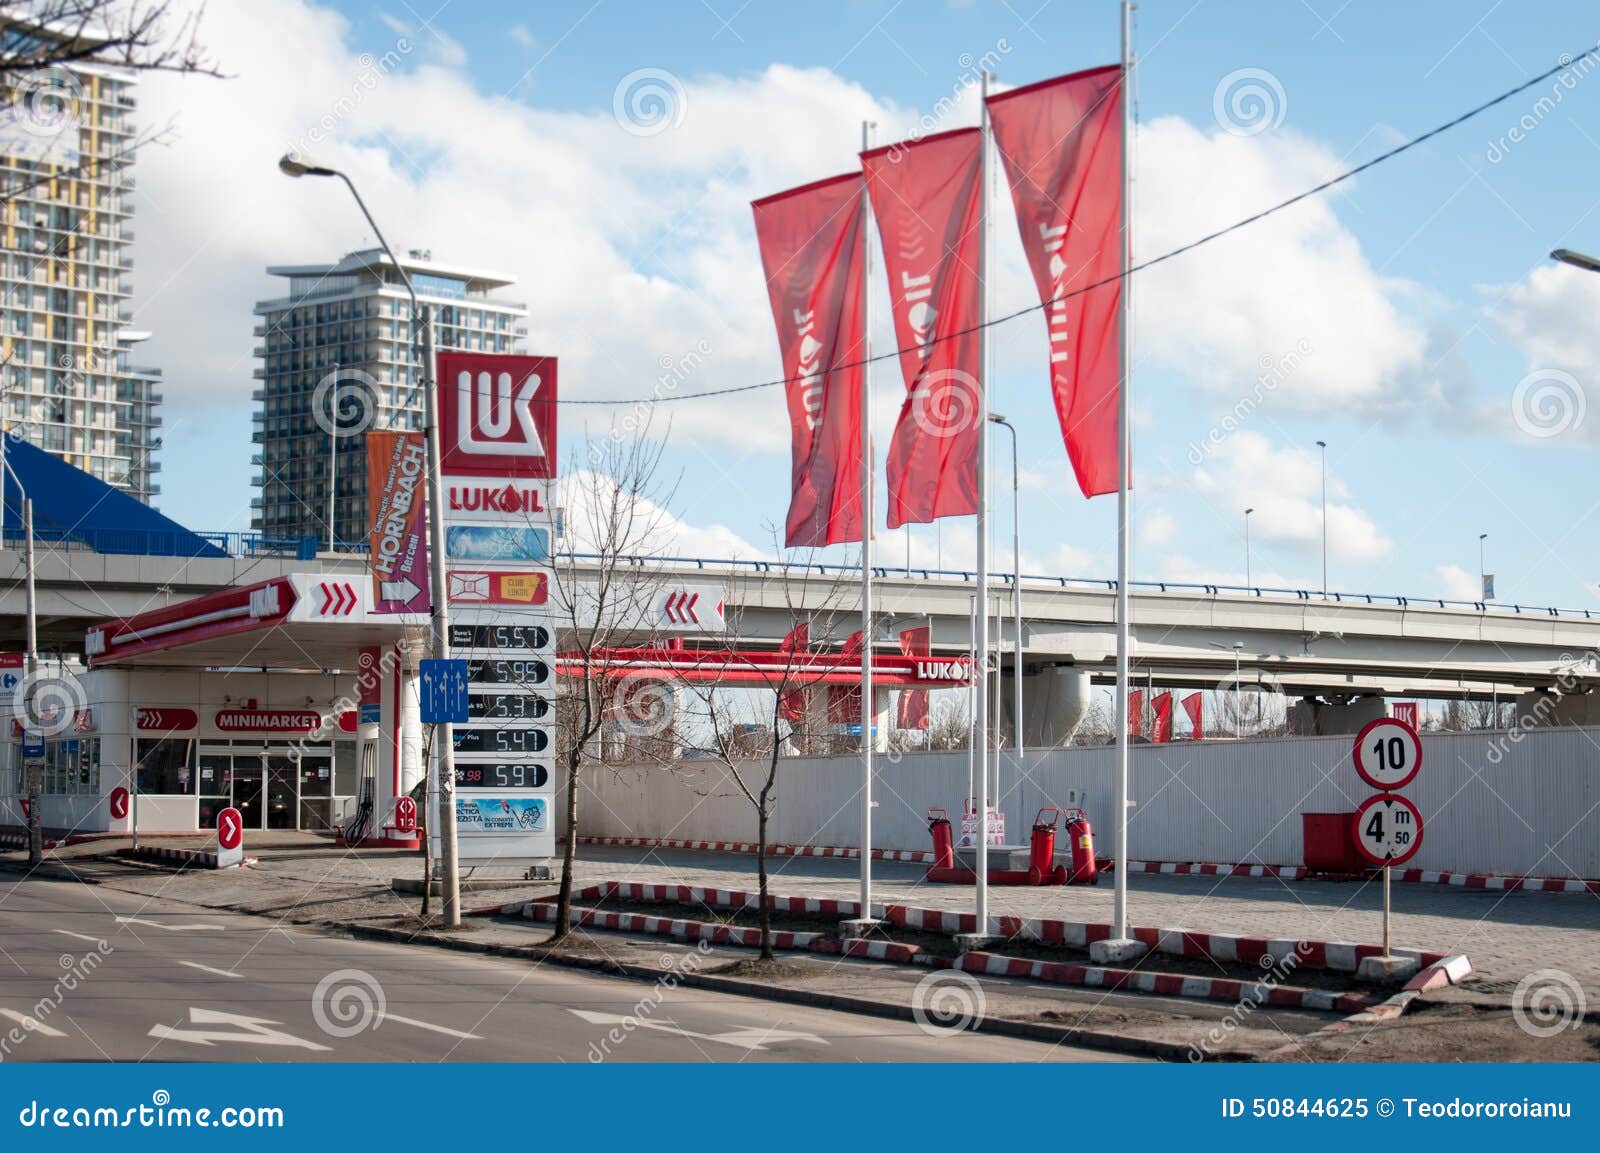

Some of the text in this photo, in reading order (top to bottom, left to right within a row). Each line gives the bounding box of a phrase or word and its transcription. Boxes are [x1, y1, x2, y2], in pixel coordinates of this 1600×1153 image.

[458, 371, 545, 456] LUK
[375, 444, 424, 574] HORNBACH
[450, 484, 544, 513] LUKOIL
[400, 533, 420, 573] Berceni
[918, 660, 977, 680] LUKOI
[219, 715, 319, 728] MINIMARKET
[496, 731, 537, 751] 5.47
[1373, 737, 1406, 770] 10
[466, 770, 482, 781] 98
[1366, 811, 1410, 843] 4 m
[1395, 832, 1410, 844] 50
